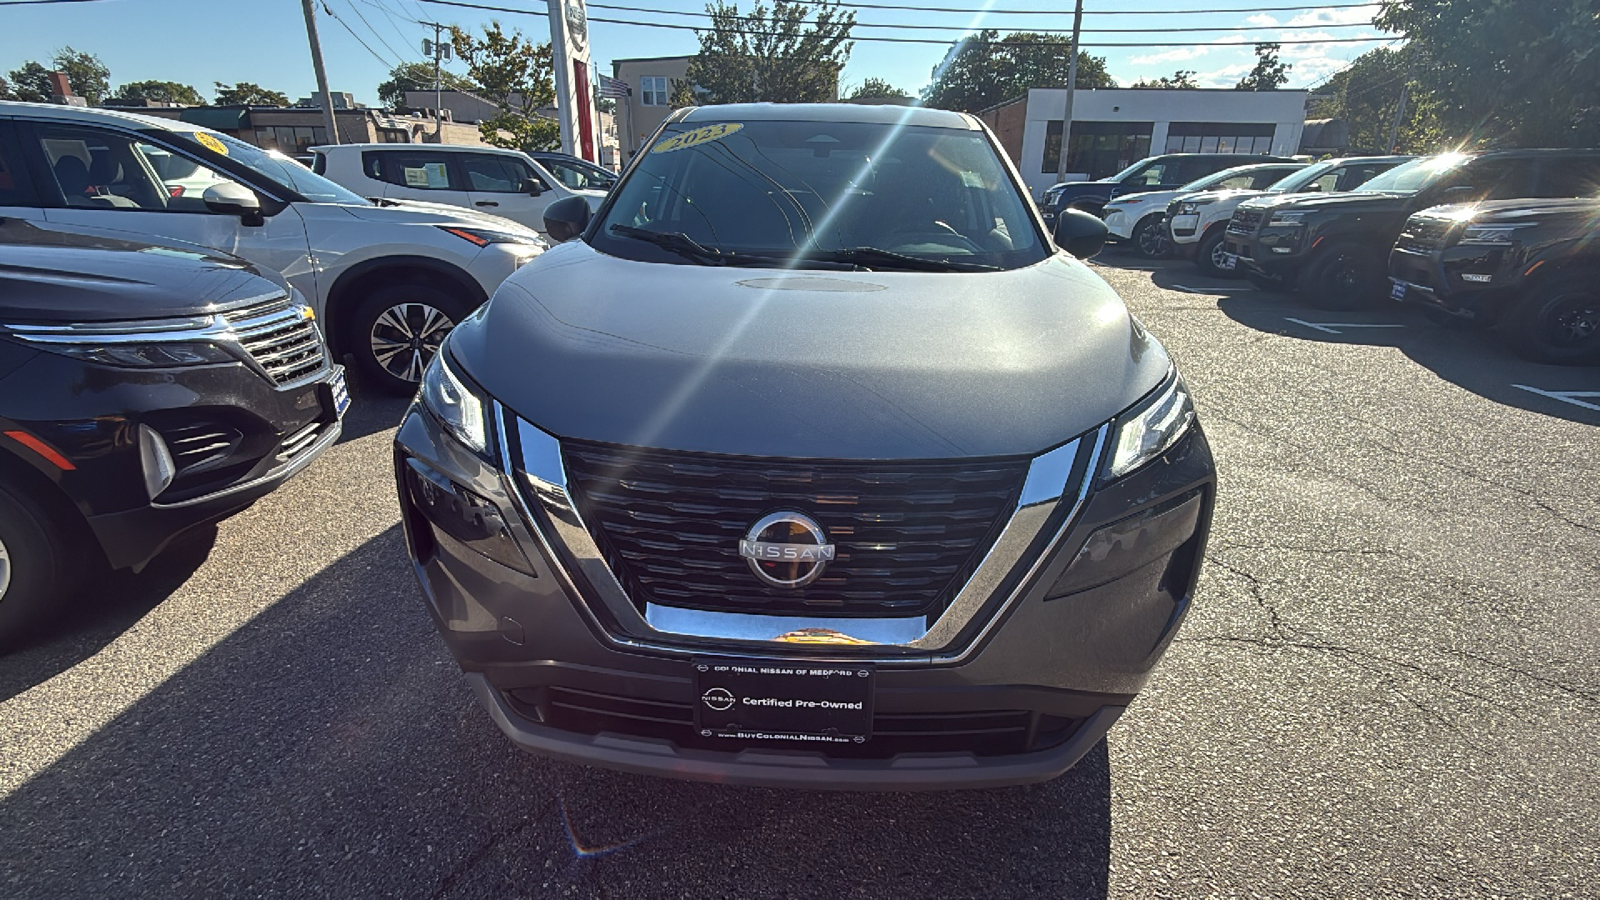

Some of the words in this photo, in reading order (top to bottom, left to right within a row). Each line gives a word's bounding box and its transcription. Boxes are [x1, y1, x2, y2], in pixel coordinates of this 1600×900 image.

[669, 125, 727, 149] 2023
[742, 542, 831, 559] NISSAN
[760, 667, 793, 675] NISSAN
[742, 697, 793, 708] Certified
[795, 700, 863, 710] Pre-Owned
